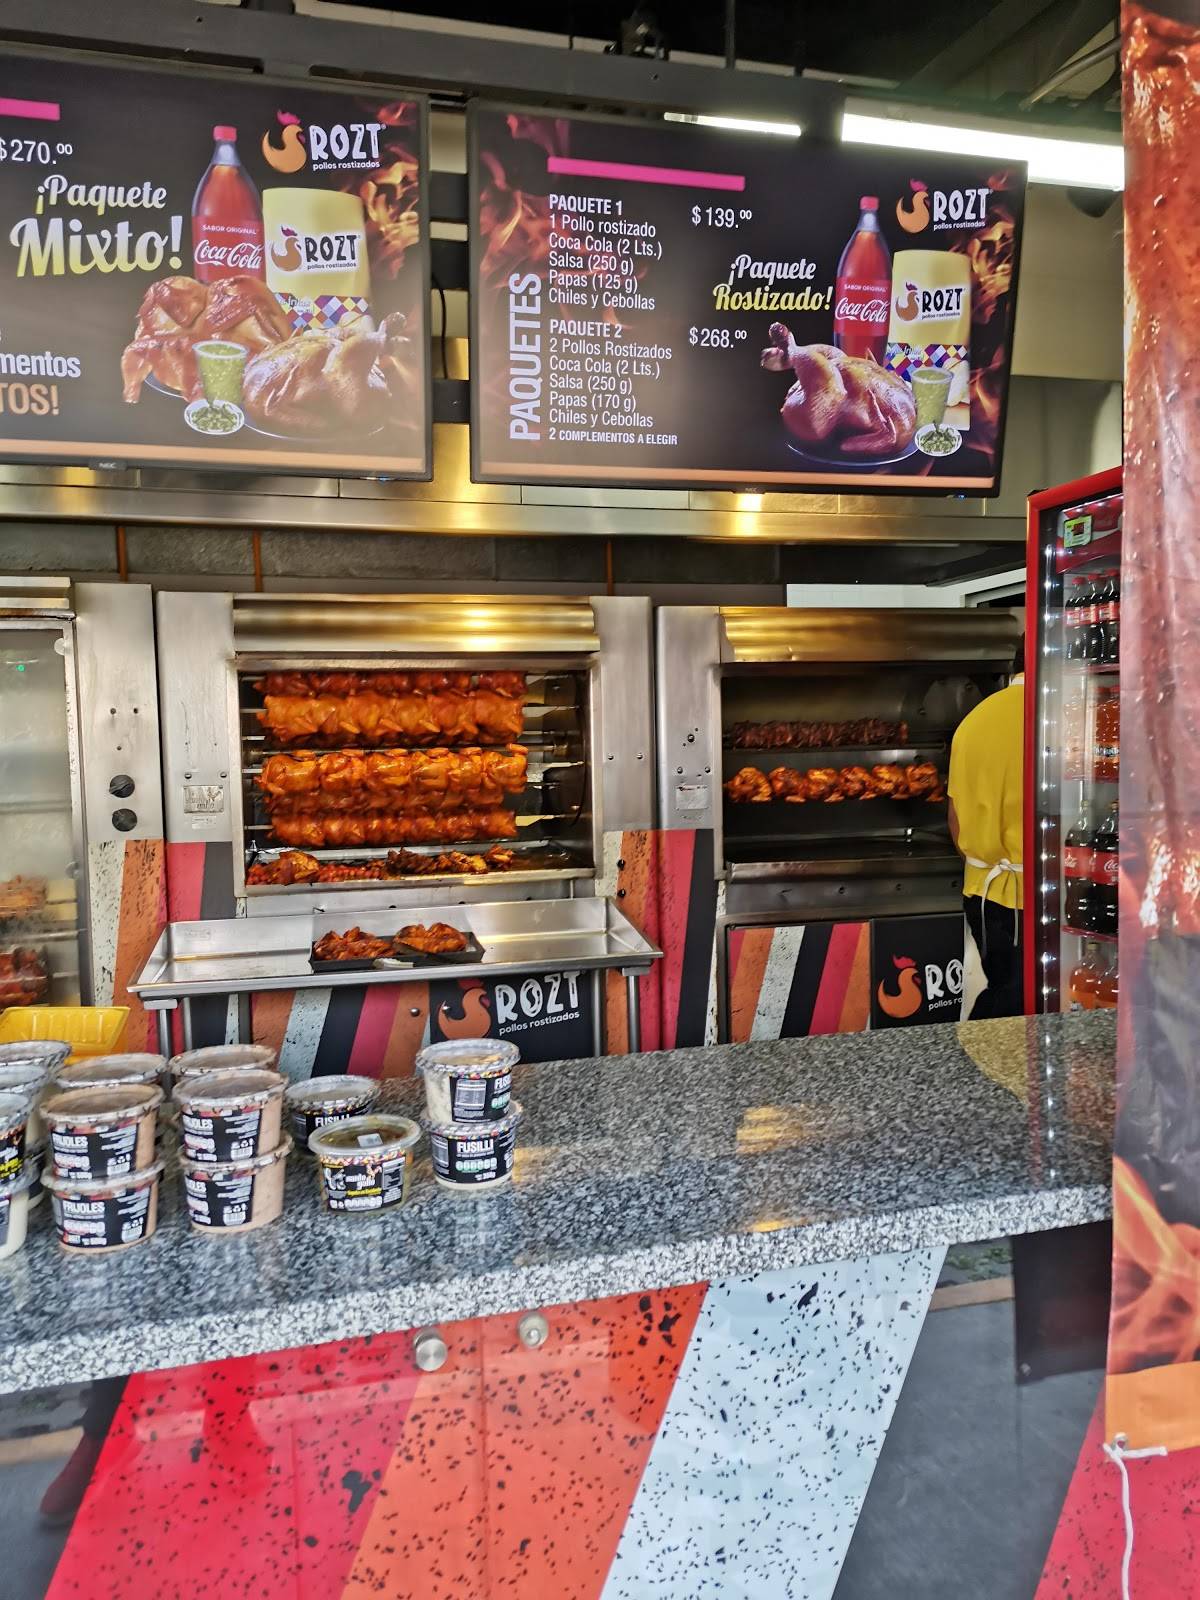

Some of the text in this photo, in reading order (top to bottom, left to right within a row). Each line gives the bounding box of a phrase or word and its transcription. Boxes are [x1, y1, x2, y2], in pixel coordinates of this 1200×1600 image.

[310, 122, 381, 161] ROZT
[313, 160, 380, 171] pollos rostizados
[35, 174, 168, 215] ¡Paquete
[549, 193, 623, 215] PAQUETE 1
[934, 188, 990, 221] ROZT
[202, 224, 257, 235] SABOR ORIGINAL
[550, 214, 656, 238] 1 Pollo rostizado
[934, 219, 985, 231] pollos rostizados
[9, 216, 183, 278] Mixto!
[193, 238, 264, 270] Coca-Cola
[305, 234, 358, 263] ROZT
[549, 232, 663, 259] Coca Cola (2 Lts.)
[307, 261, 357, 271] pollos rostizados
[549, 251, 634, 275] Salsa (250 g)
[729, 254, 817, 286] ¡Paquete
[549, 270, 638, 294] Papas (125 g)
[549, 287, 655, 310] Chiles y Cebollas
[712, 283, 833, 312] Rostizado!
[922, 288, 963, 311] ROZT
[835, 297, 890, 323] Coca-Cola
[549, 319, 622, 338] PAQUETE 2
[509, 273, 542, 441] PAQUETES
[549, 338, 672, 360] 2 Pollos Rostizados
[549, 355, 660, 379] Coca Cola (2 Lts.)
[549, 374, 632, 394] Salsa (250 g)
[549, 392, 637, 413] Papas (170 g)
[549, 408, 653, 428] Chiles y Cebollas
[549, 427, 677, 446] 2 COMPLEMENTOS A ELEGIR
[495, 970, 581, 1024] ROZT
[928, 998, 953, 1012] pollos
[499, 1010, 580, 1036] pollos rostizados
[457, 1139, 494, 1154] FUSILLI
